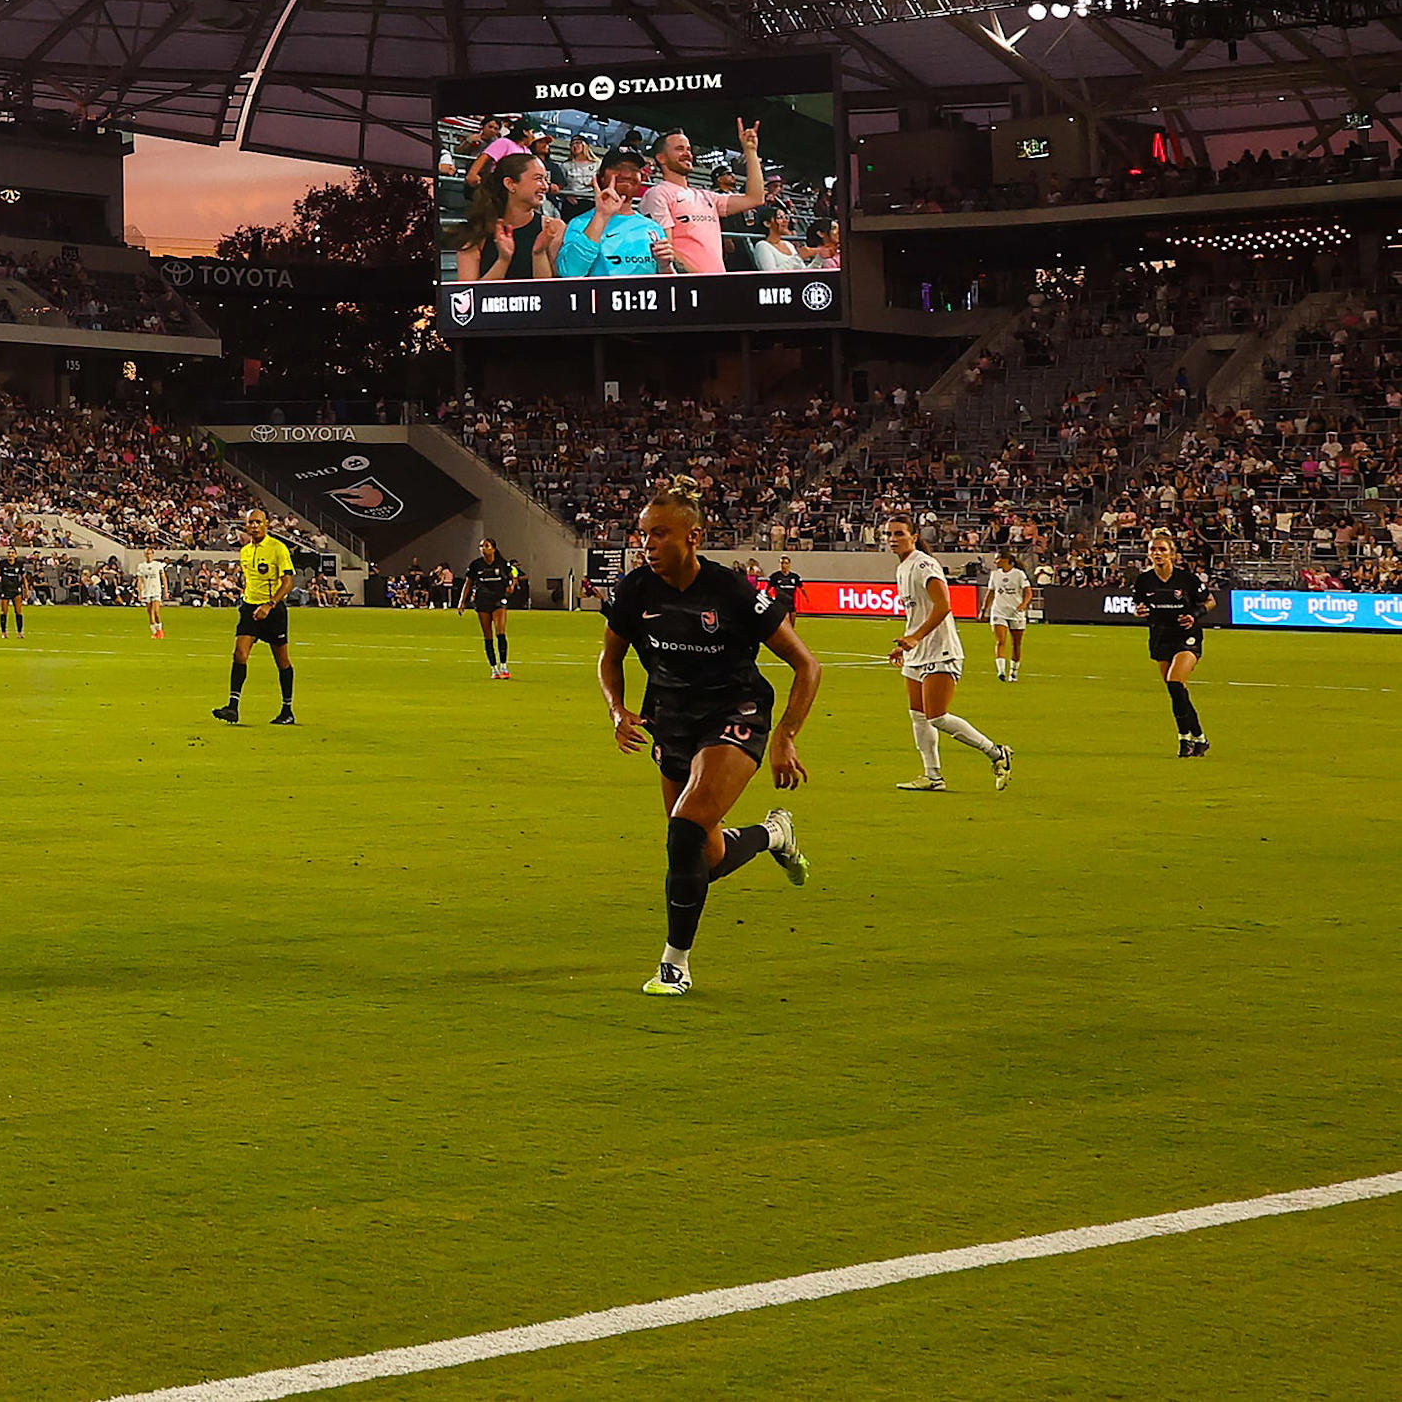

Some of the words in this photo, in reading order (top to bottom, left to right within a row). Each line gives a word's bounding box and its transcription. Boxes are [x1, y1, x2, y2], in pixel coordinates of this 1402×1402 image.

[534, 82, 586, 99] BMO
[618, 73, 723, 95] STADIUM
[198, 265, 293, 288] TOYOTA
[530, 295, 541, 311] FC
[569, 293, 577, 311] 1
[611, 290, 658, 311] 51:12
[690, 289, 698, 307] 1
[779, 287, 792, 304] FC
[65, 359, 81, 371] 135
[281, 426, 356, 441] TOYOTA
[294, 466, 339, 480] BMO
[839, 587, 906, 615] HubSp
[1243, 593, 1292, 612] prime
[1308, 594, 1358, 613] prime
[1374, 597, 1402, 616] pri
[661, 641, 725, 655] DOORDASH
